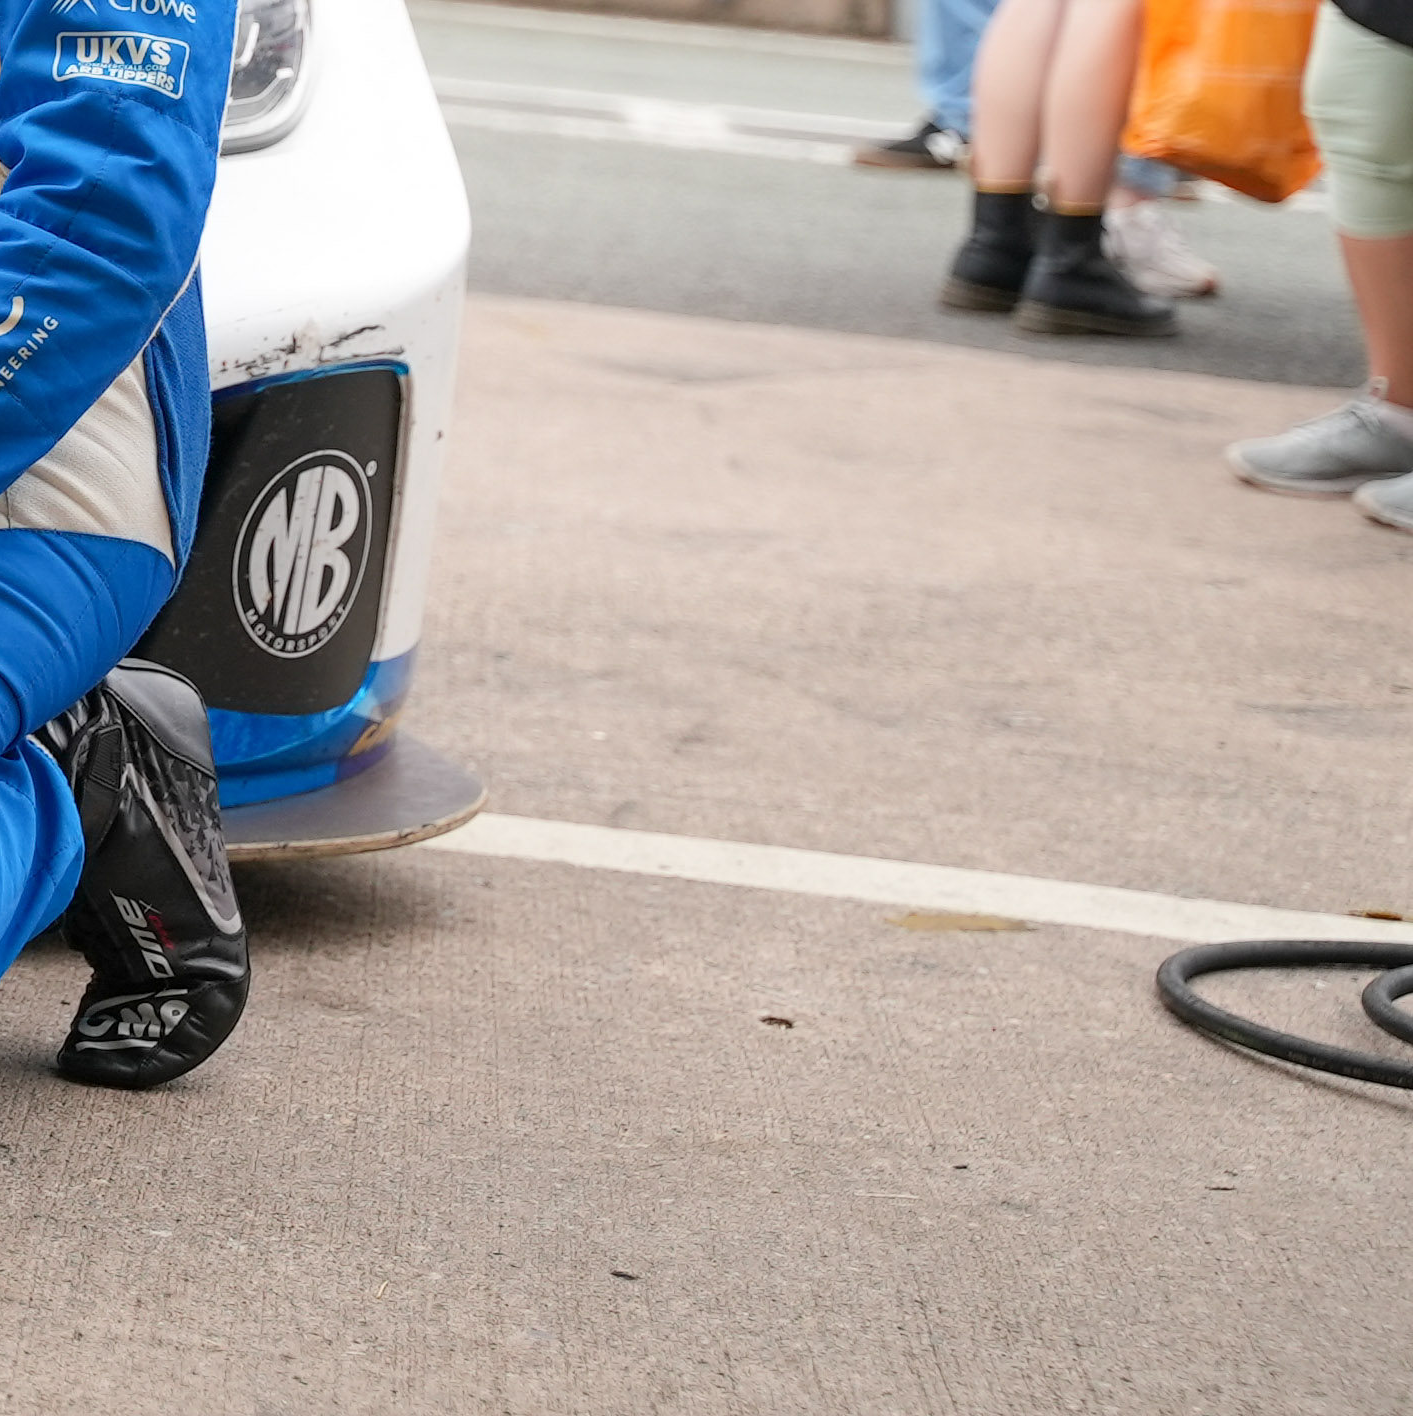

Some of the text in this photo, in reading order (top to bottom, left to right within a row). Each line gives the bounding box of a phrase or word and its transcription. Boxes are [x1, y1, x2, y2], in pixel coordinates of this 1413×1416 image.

[76, 37, 171, 66] UKVS
[65, 64, 175, 92] ARB TIPPERS
[248, 464, 361, 635] MB
[244, 604, 347, 652] MOTORSPORT
